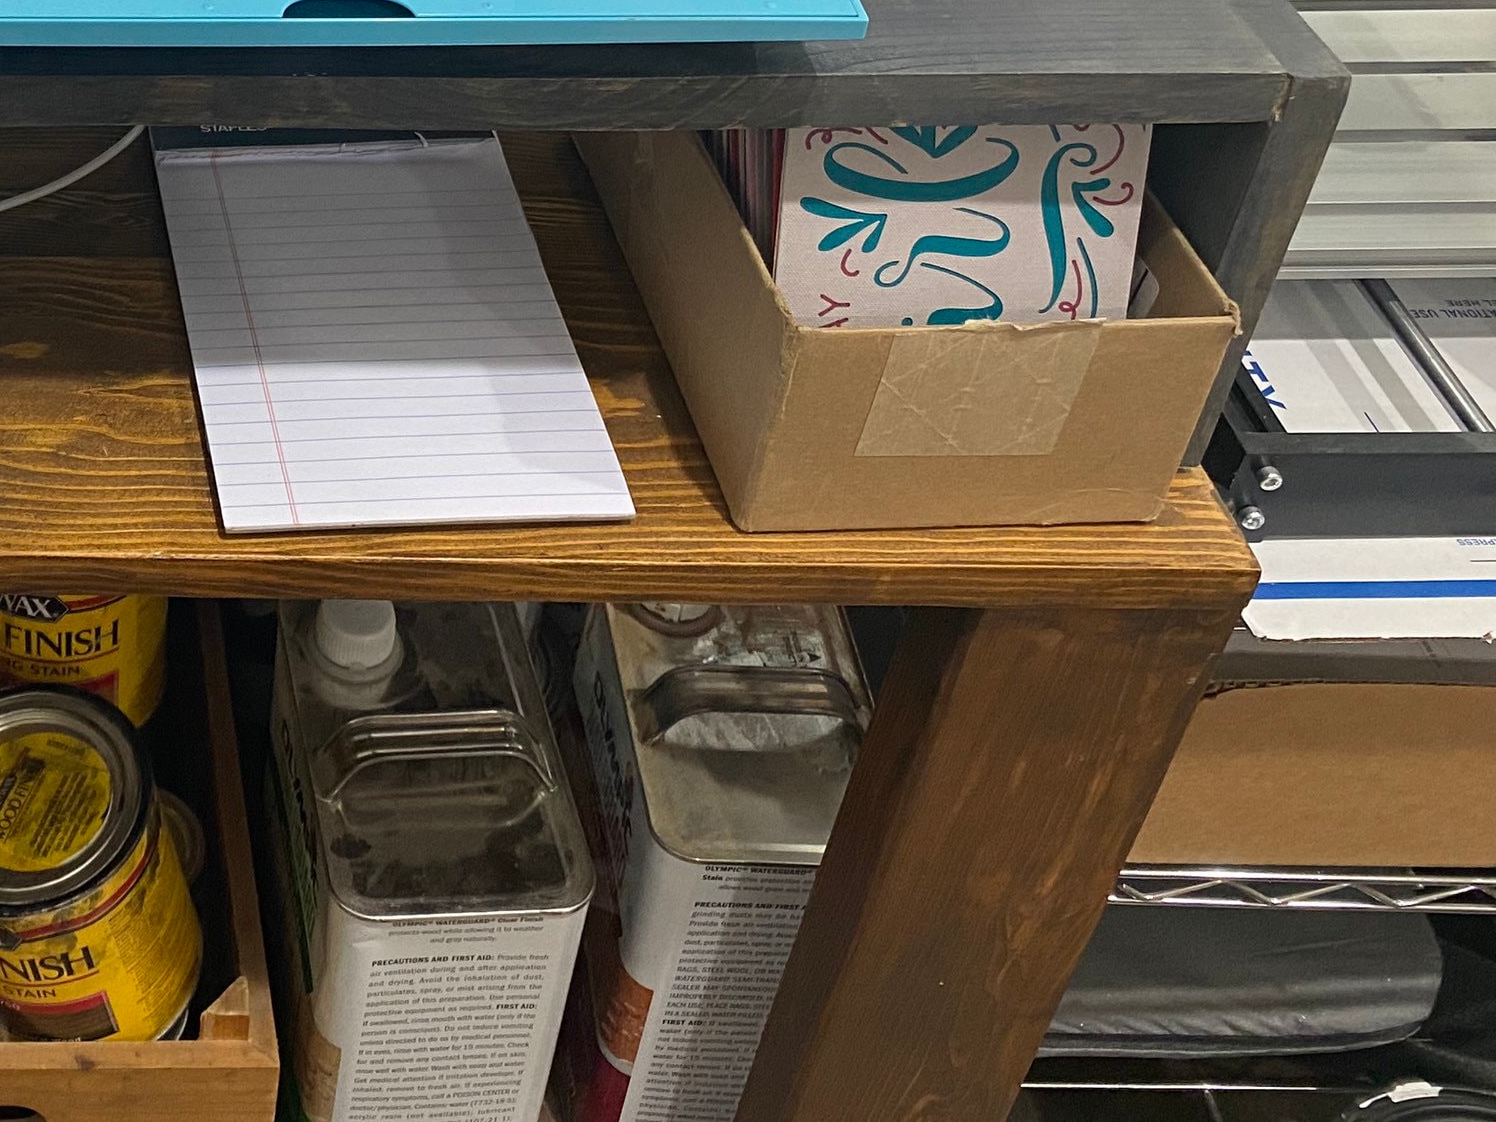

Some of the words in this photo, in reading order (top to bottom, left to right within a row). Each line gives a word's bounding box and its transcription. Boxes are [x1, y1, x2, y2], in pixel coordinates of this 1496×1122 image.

[1409, 309, 1439, 319] USE
[4, 618, 120, 658] FINISH
[28, 663, 82, 677] STAIN
[372, 957, 429, 967] PRECAUTIONS
[12, 986, 57, 999] STAIN
